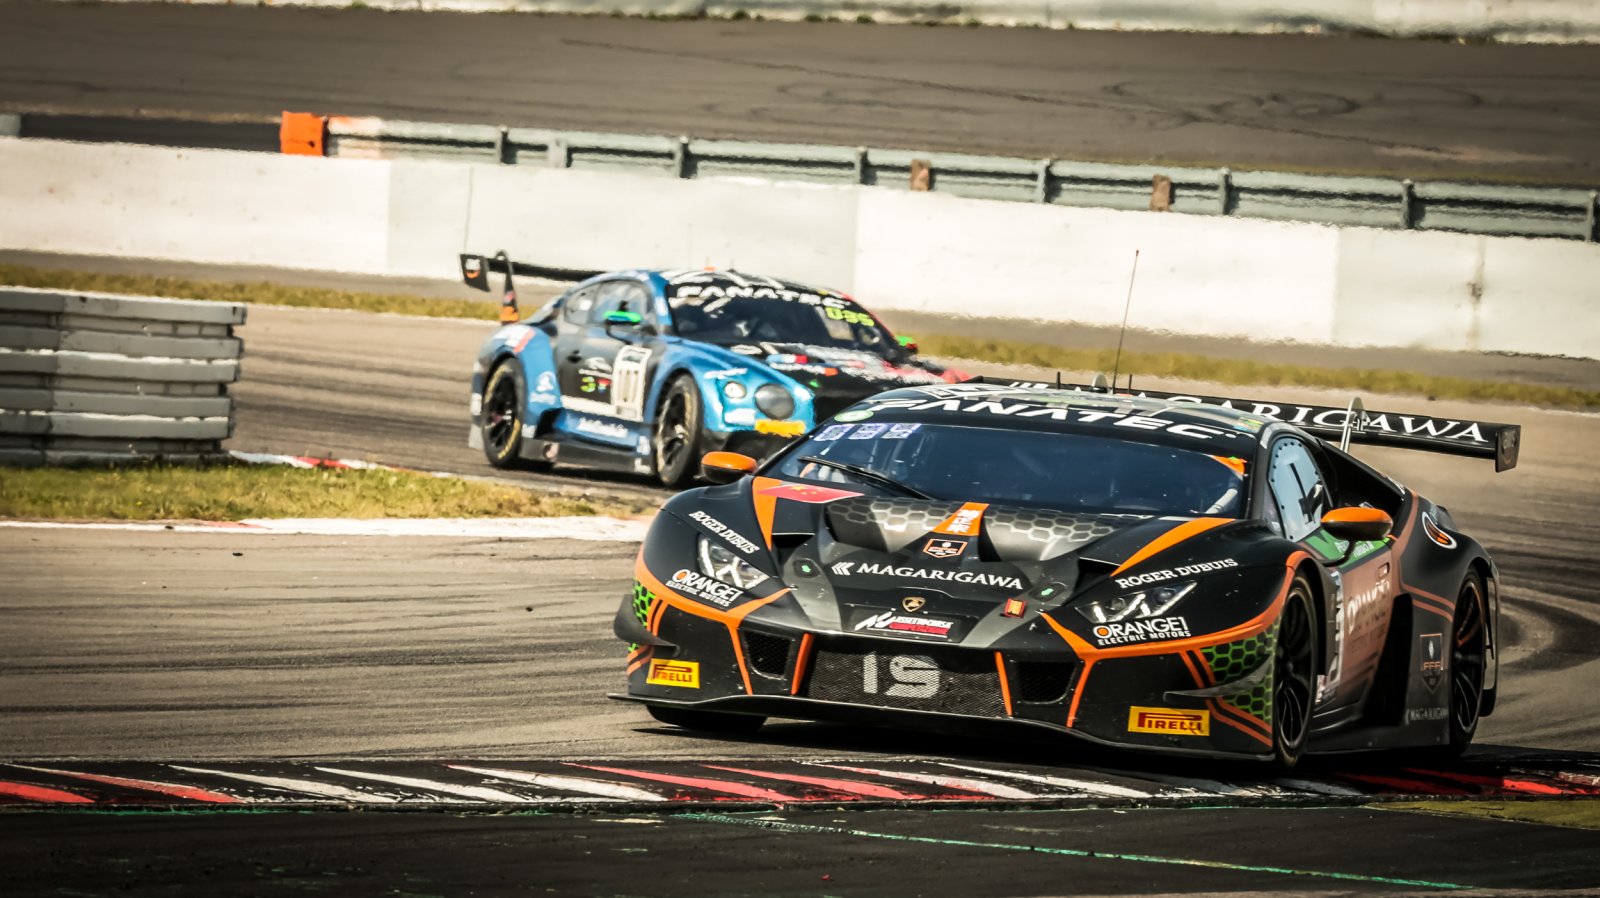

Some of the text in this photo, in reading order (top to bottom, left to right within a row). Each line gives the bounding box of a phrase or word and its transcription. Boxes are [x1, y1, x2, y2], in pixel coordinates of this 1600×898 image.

[867, 399, 1222, 439] FANATEC
[689, 510, 728, 536] ROGER
[856, 562, 1024, 590] MAGARIGAWA
[1115, 558, 1239, 588] ROGER DUBUIS
[1093, 616, 1190, 639] ORANGE1
[1098, 630, 1192, 646] ELECTRIC MOTORS
[653, 664, 693, 683] PIRELLI
[863, 653, 940, 698] 19
[1138, 711, 1203, 733] PIRELLI
